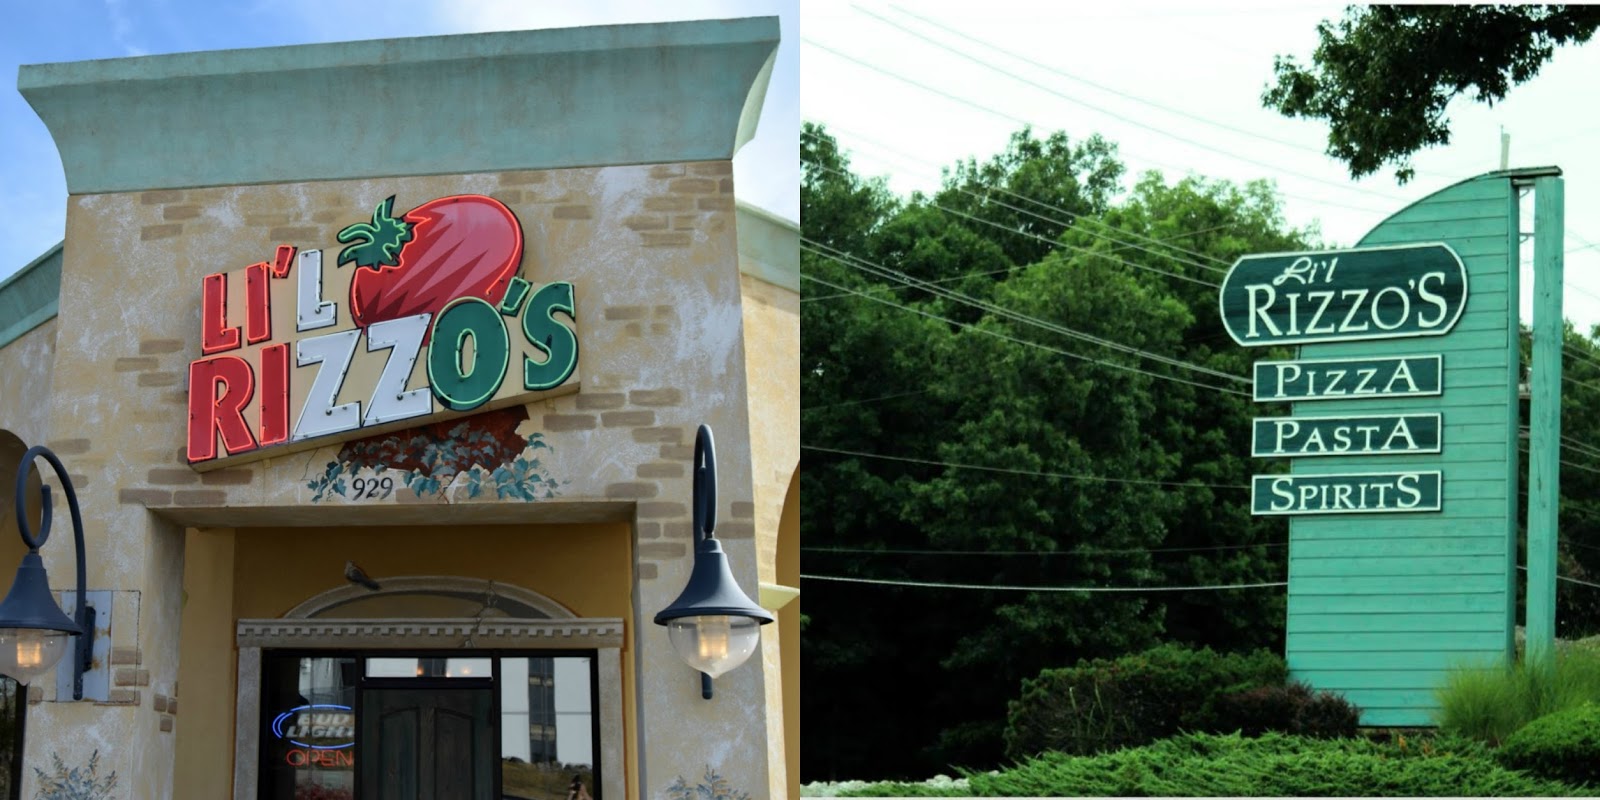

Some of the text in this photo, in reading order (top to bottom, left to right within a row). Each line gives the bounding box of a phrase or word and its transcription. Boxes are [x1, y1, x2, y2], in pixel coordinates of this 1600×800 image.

[1273, 256, 1338, 286] Li'l
[201, 245, 338, 355] LI'L
[1244, 272, 1448, 338] RIZZO'S
[187, 277, 579, 463] RIZZO'S
[1274, 359, 1420, 397] PIZZA
[1273, 417, 1419, 453] PASTA
[352, 478, 394, 501] 929
[1270, 474, 1422, 511] SPIRITS
[297, 713, 351, 727] BUD
[286, 749, 353, 766] OPEN
